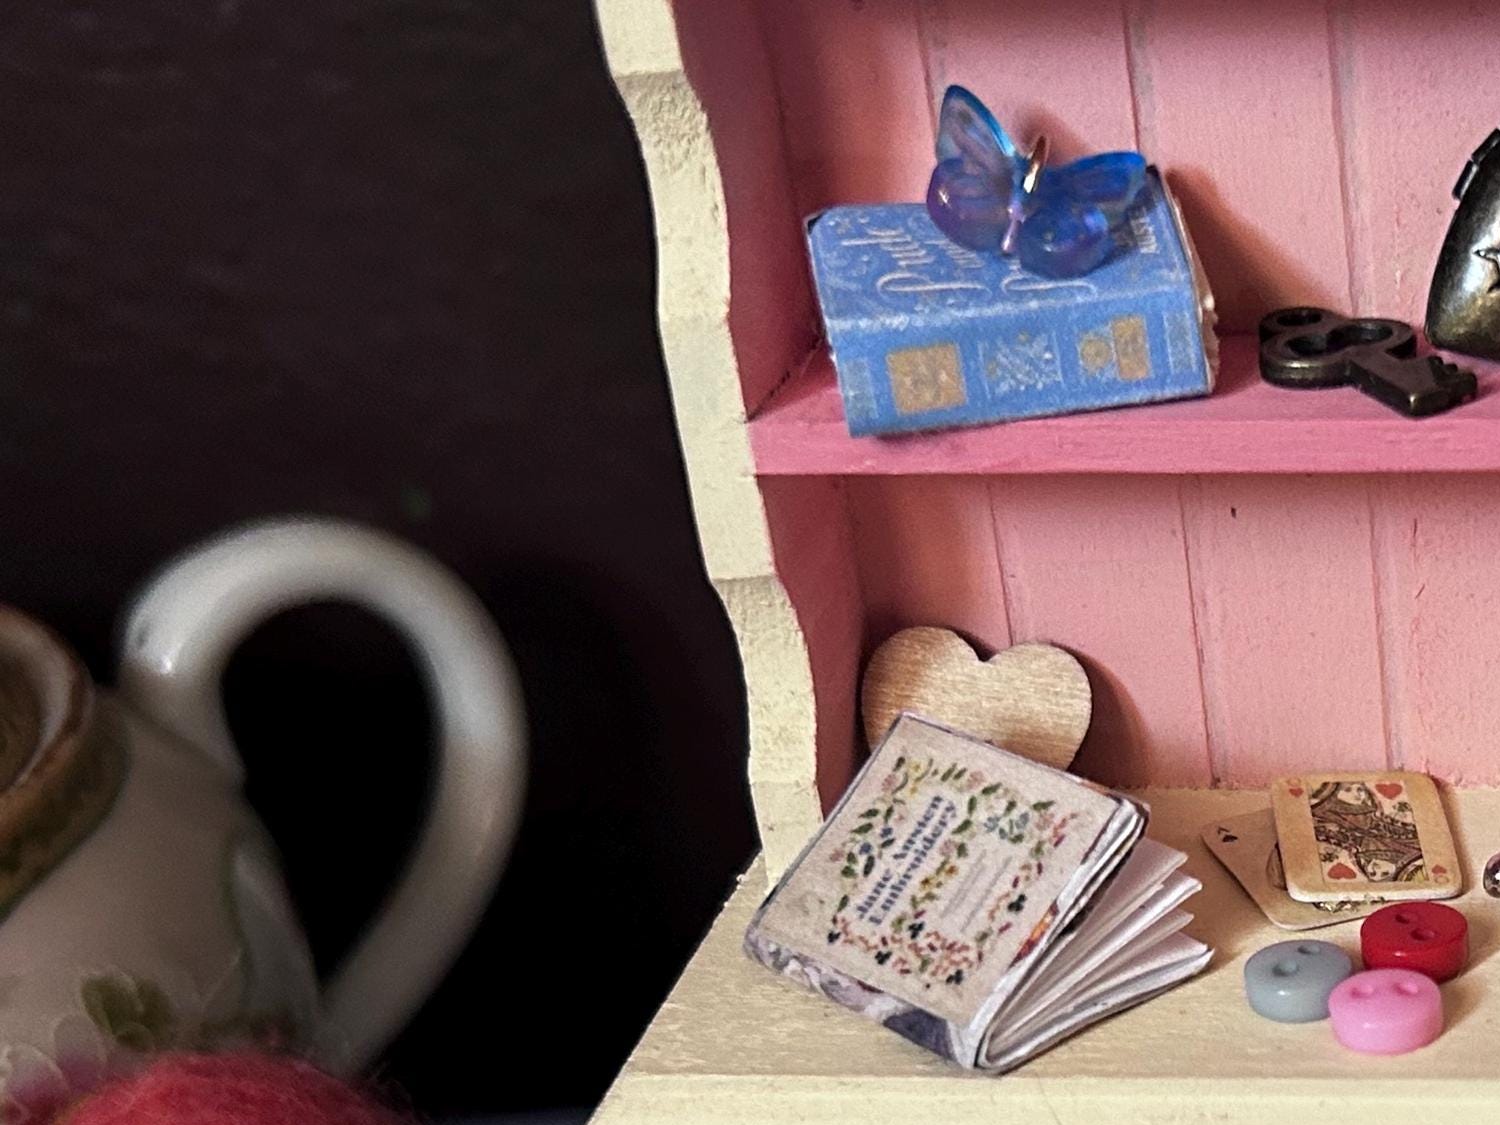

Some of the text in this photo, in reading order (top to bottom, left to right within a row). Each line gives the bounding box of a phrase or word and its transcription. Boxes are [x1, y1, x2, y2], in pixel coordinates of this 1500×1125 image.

[856, 794, 944, 920] Jane Austen
[868, 800, 957, 926] Embroidery
